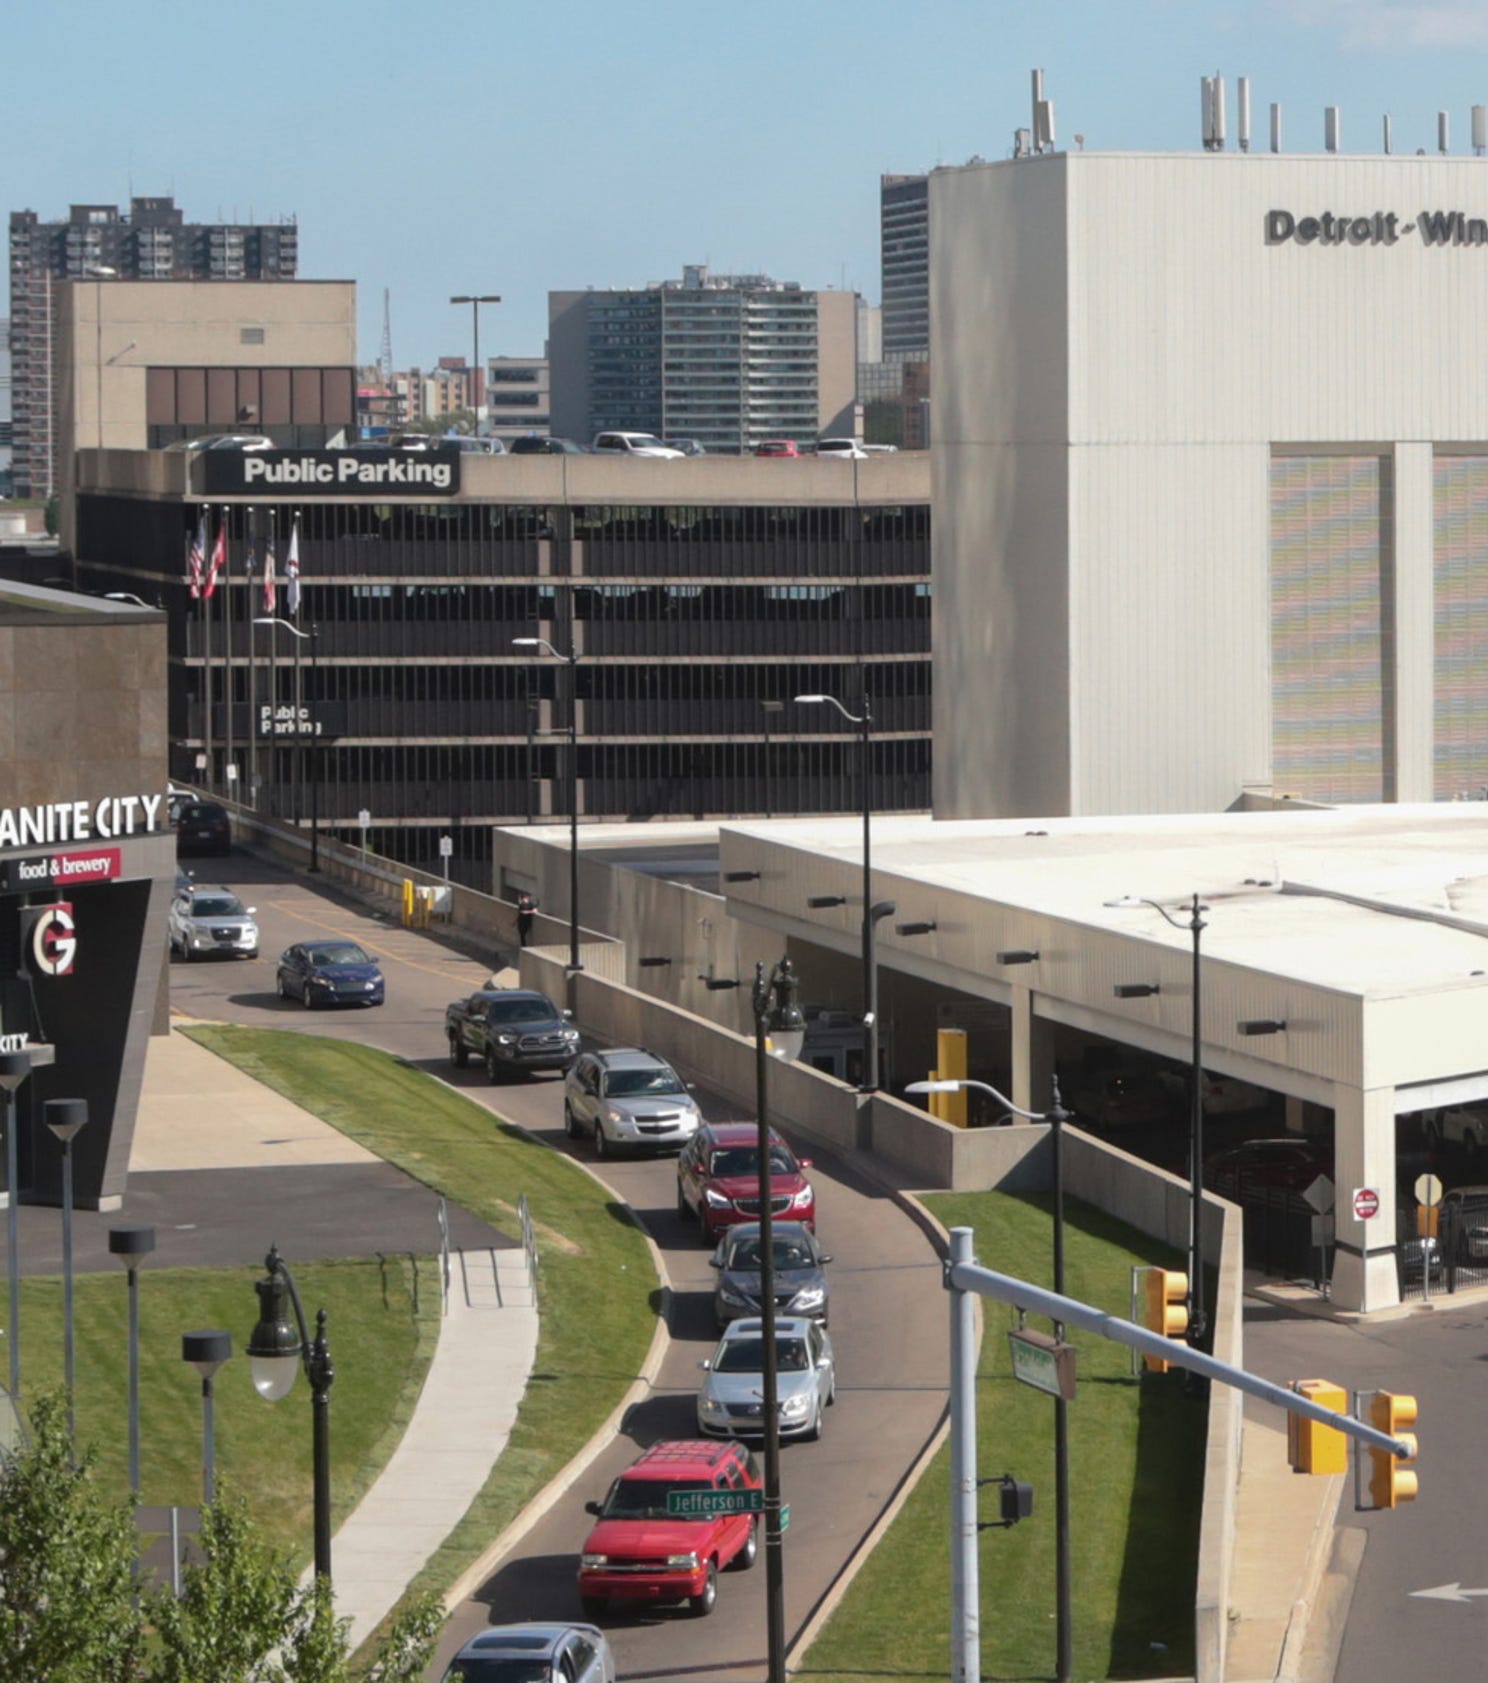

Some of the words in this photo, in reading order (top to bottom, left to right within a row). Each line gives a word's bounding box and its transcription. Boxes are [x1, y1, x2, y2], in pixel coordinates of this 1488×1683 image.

[244, 457, 334, 483] Public
[338, 457, 451, 488] Parking
[96, 794, 161, 838] CITY
[19, 858, 48, 880] food
[49, 857, 60, 877] &
[62, 856, 111, 876] brewery
[0, 1032, 28, 1053] CITY
[674, 1493, 745, 1512] Jefferson
[751, 1492, 758, 1509] E
